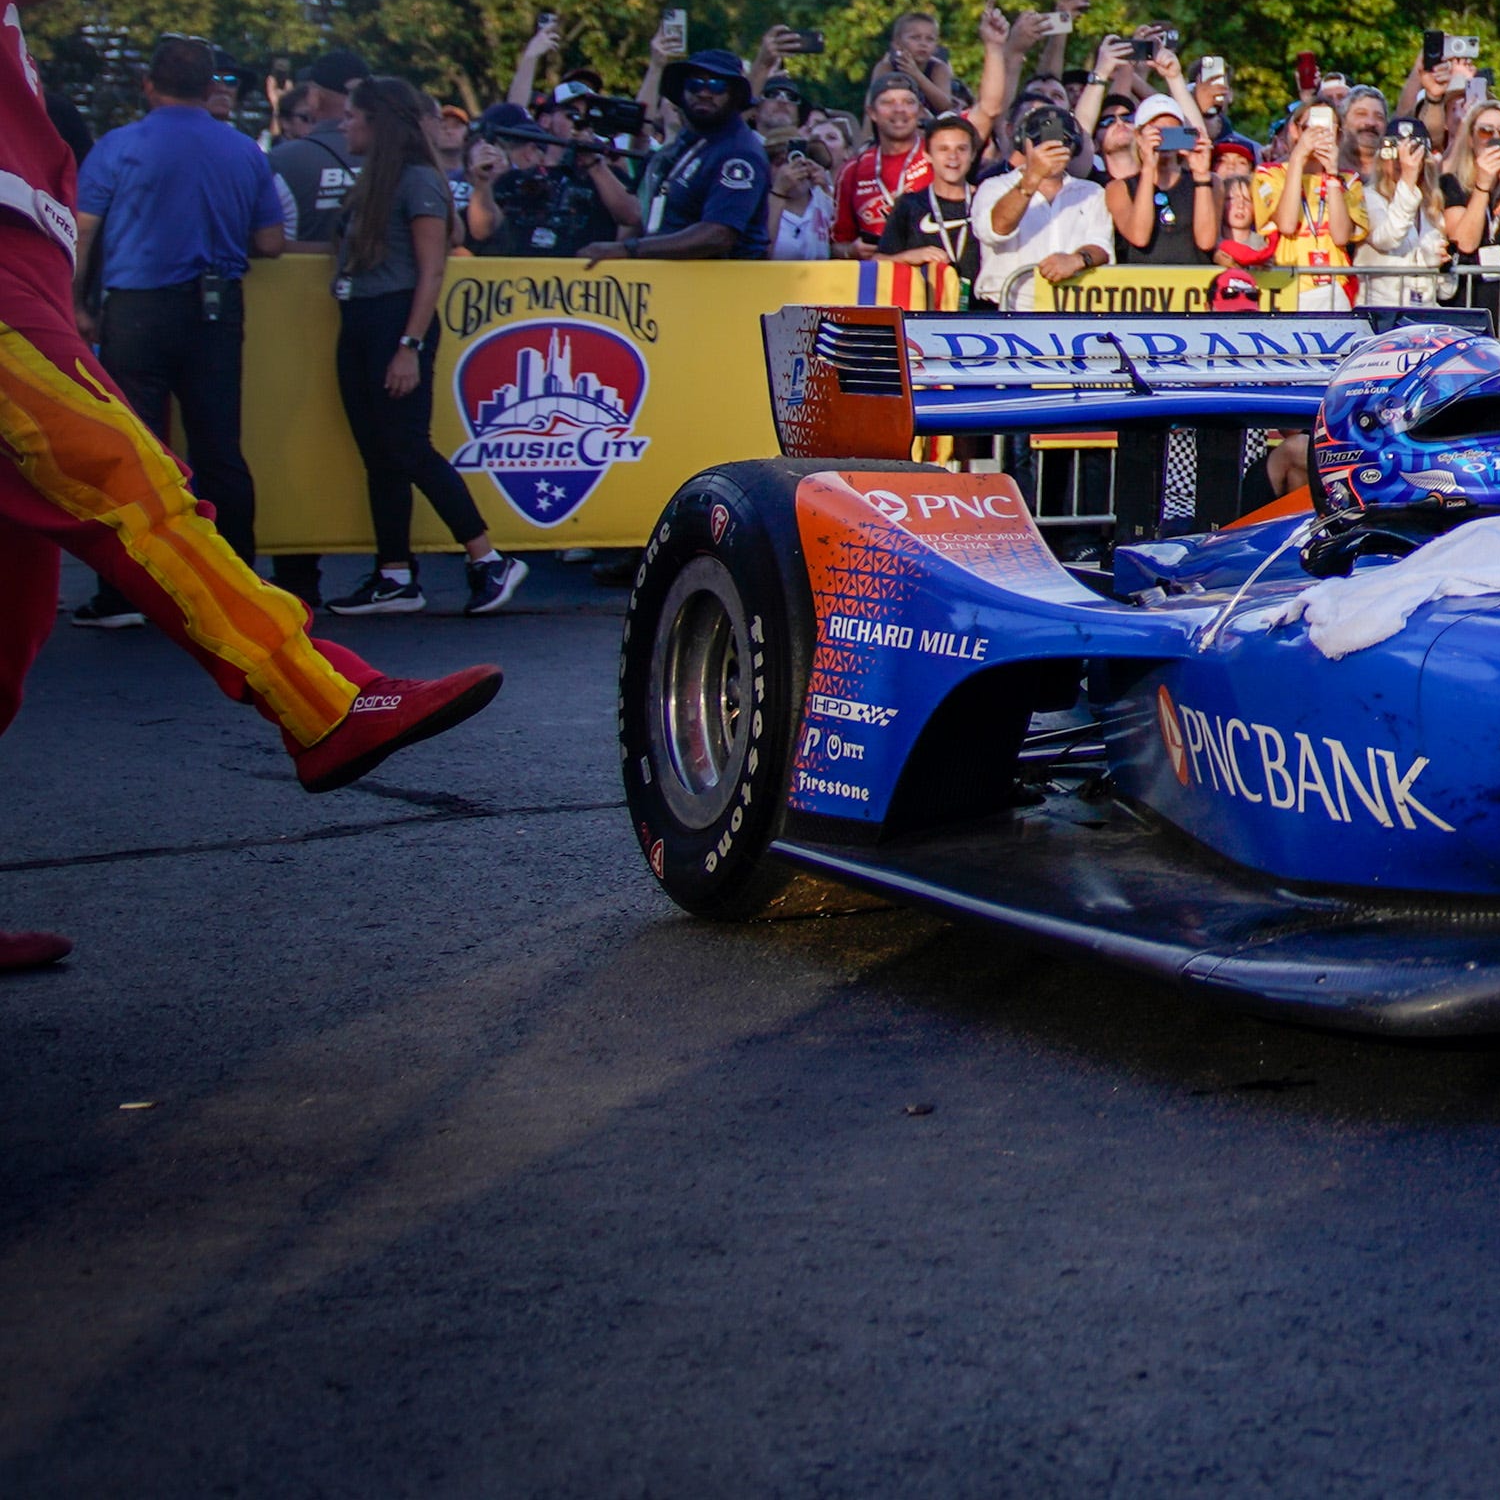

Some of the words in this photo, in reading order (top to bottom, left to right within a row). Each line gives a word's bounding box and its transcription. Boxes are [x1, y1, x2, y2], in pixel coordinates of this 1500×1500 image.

[445, 277, 515, 340] BIG
[515, 275, 659, 343] MACHINE
[479, 440, 575, 461] MUSIC
[577, 426, 647, 467] CITY
[486, 459, 539, 468] GRAND
[542, 459, 578, 468] PRIX
[911, 493, 1019, 519] PNC
[933, 540, 995, 551] DENTAL
[829, 615, 914, 650] RICHARD
[919, 630, 989, 661] MILLE
[350, 694, 402, 713] parco
[813, 700, 852, 717] HPD
[704, 614, 766, 875] Firestone
[842, 741, 865, 761] NTT
[1178, 703, 1457, 832] PNCBANK
[798, 770, 871, 802] Firestone
